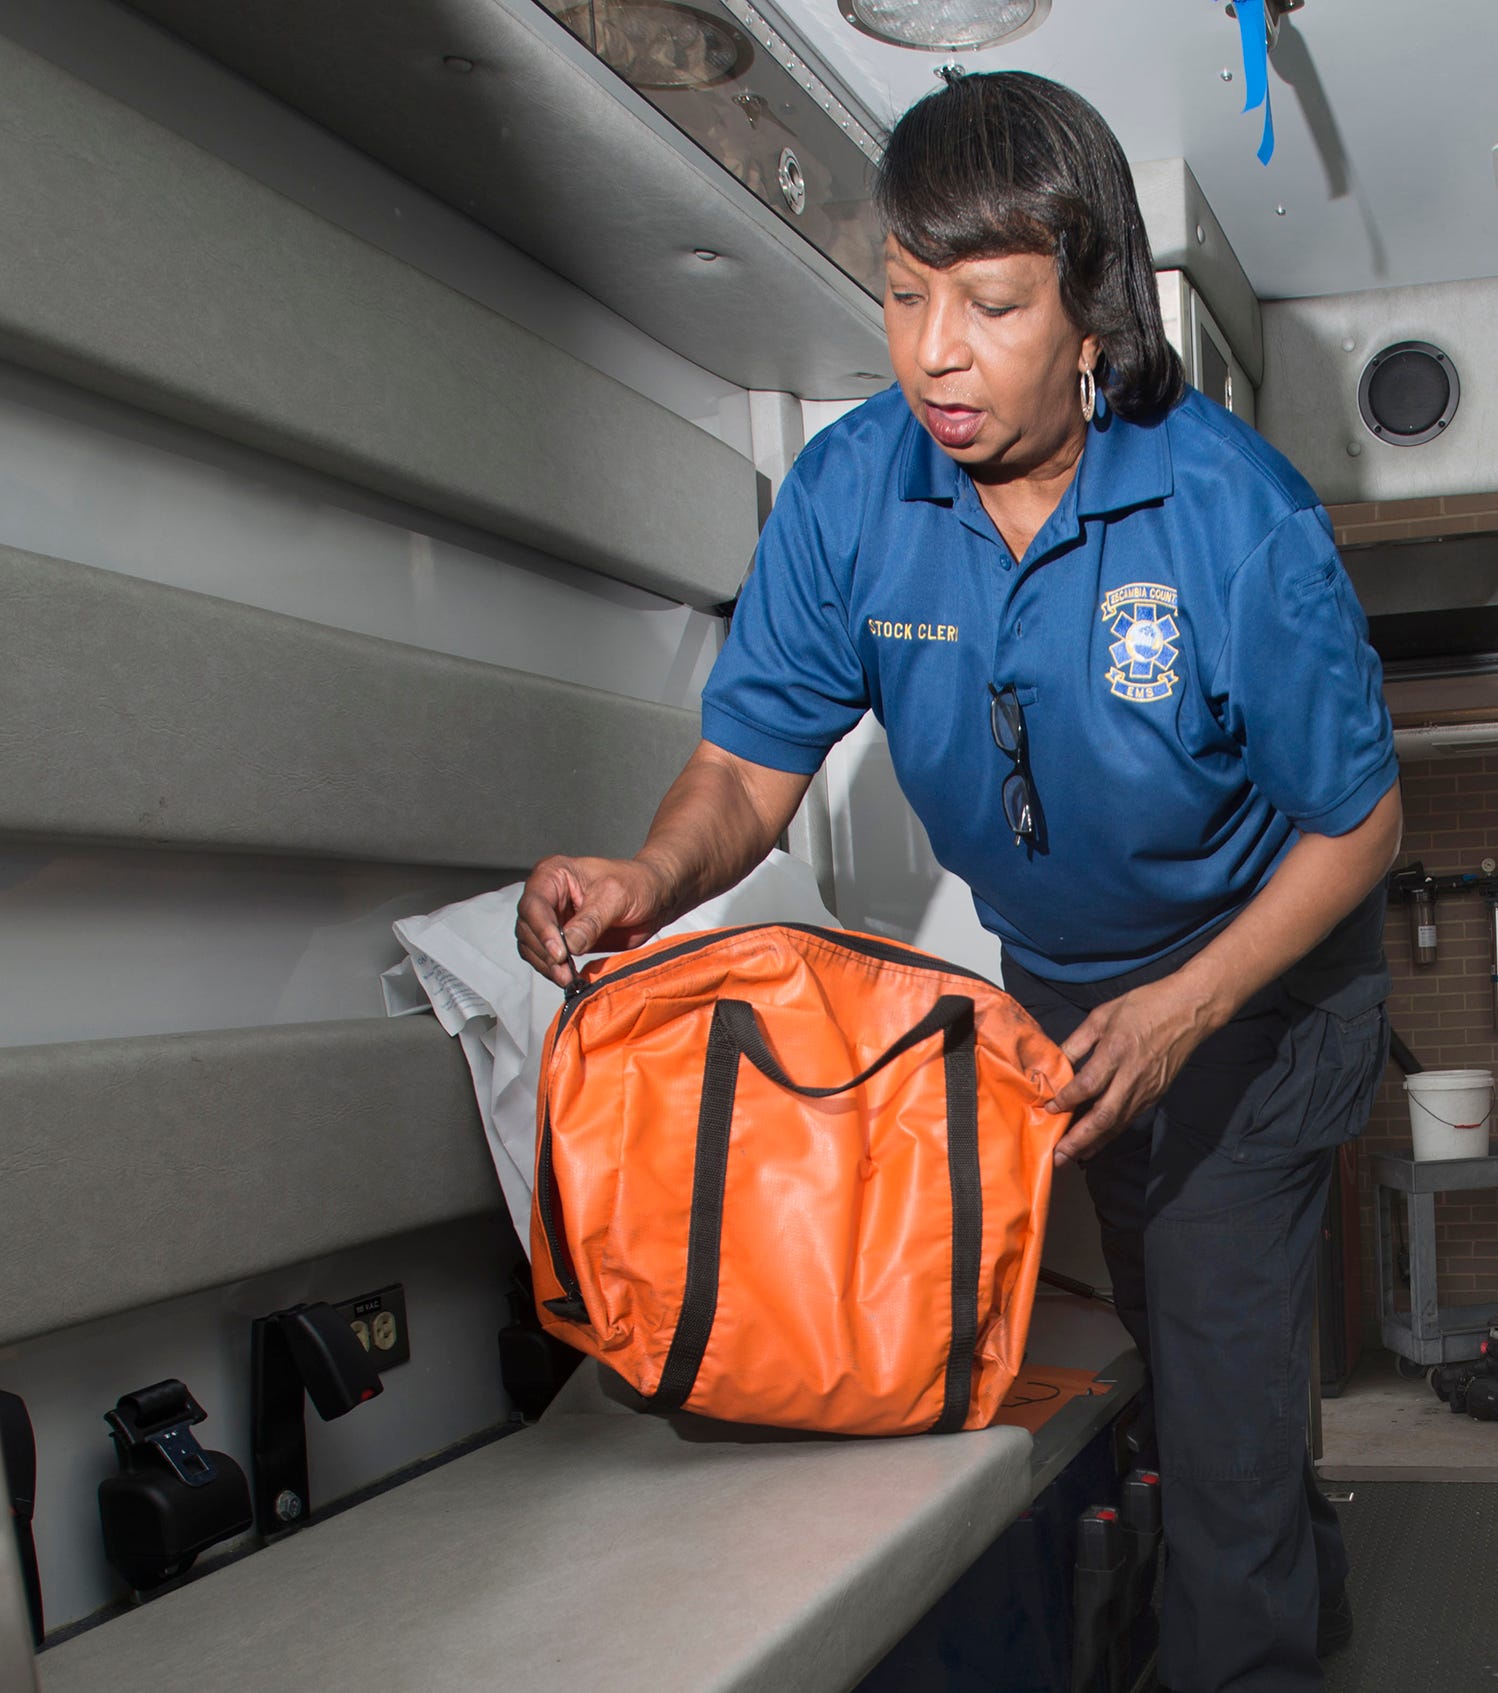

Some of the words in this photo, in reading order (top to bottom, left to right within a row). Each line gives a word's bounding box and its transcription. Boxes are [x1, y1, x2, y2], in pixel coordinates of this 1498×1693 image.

[1110, 586, 1147, 604] ESCAMBIA
[1150, 588, 1178, 604] COUNT
[868, 619, 913, 640] STOCK
[1127, 686, 1154, 697] EMS
